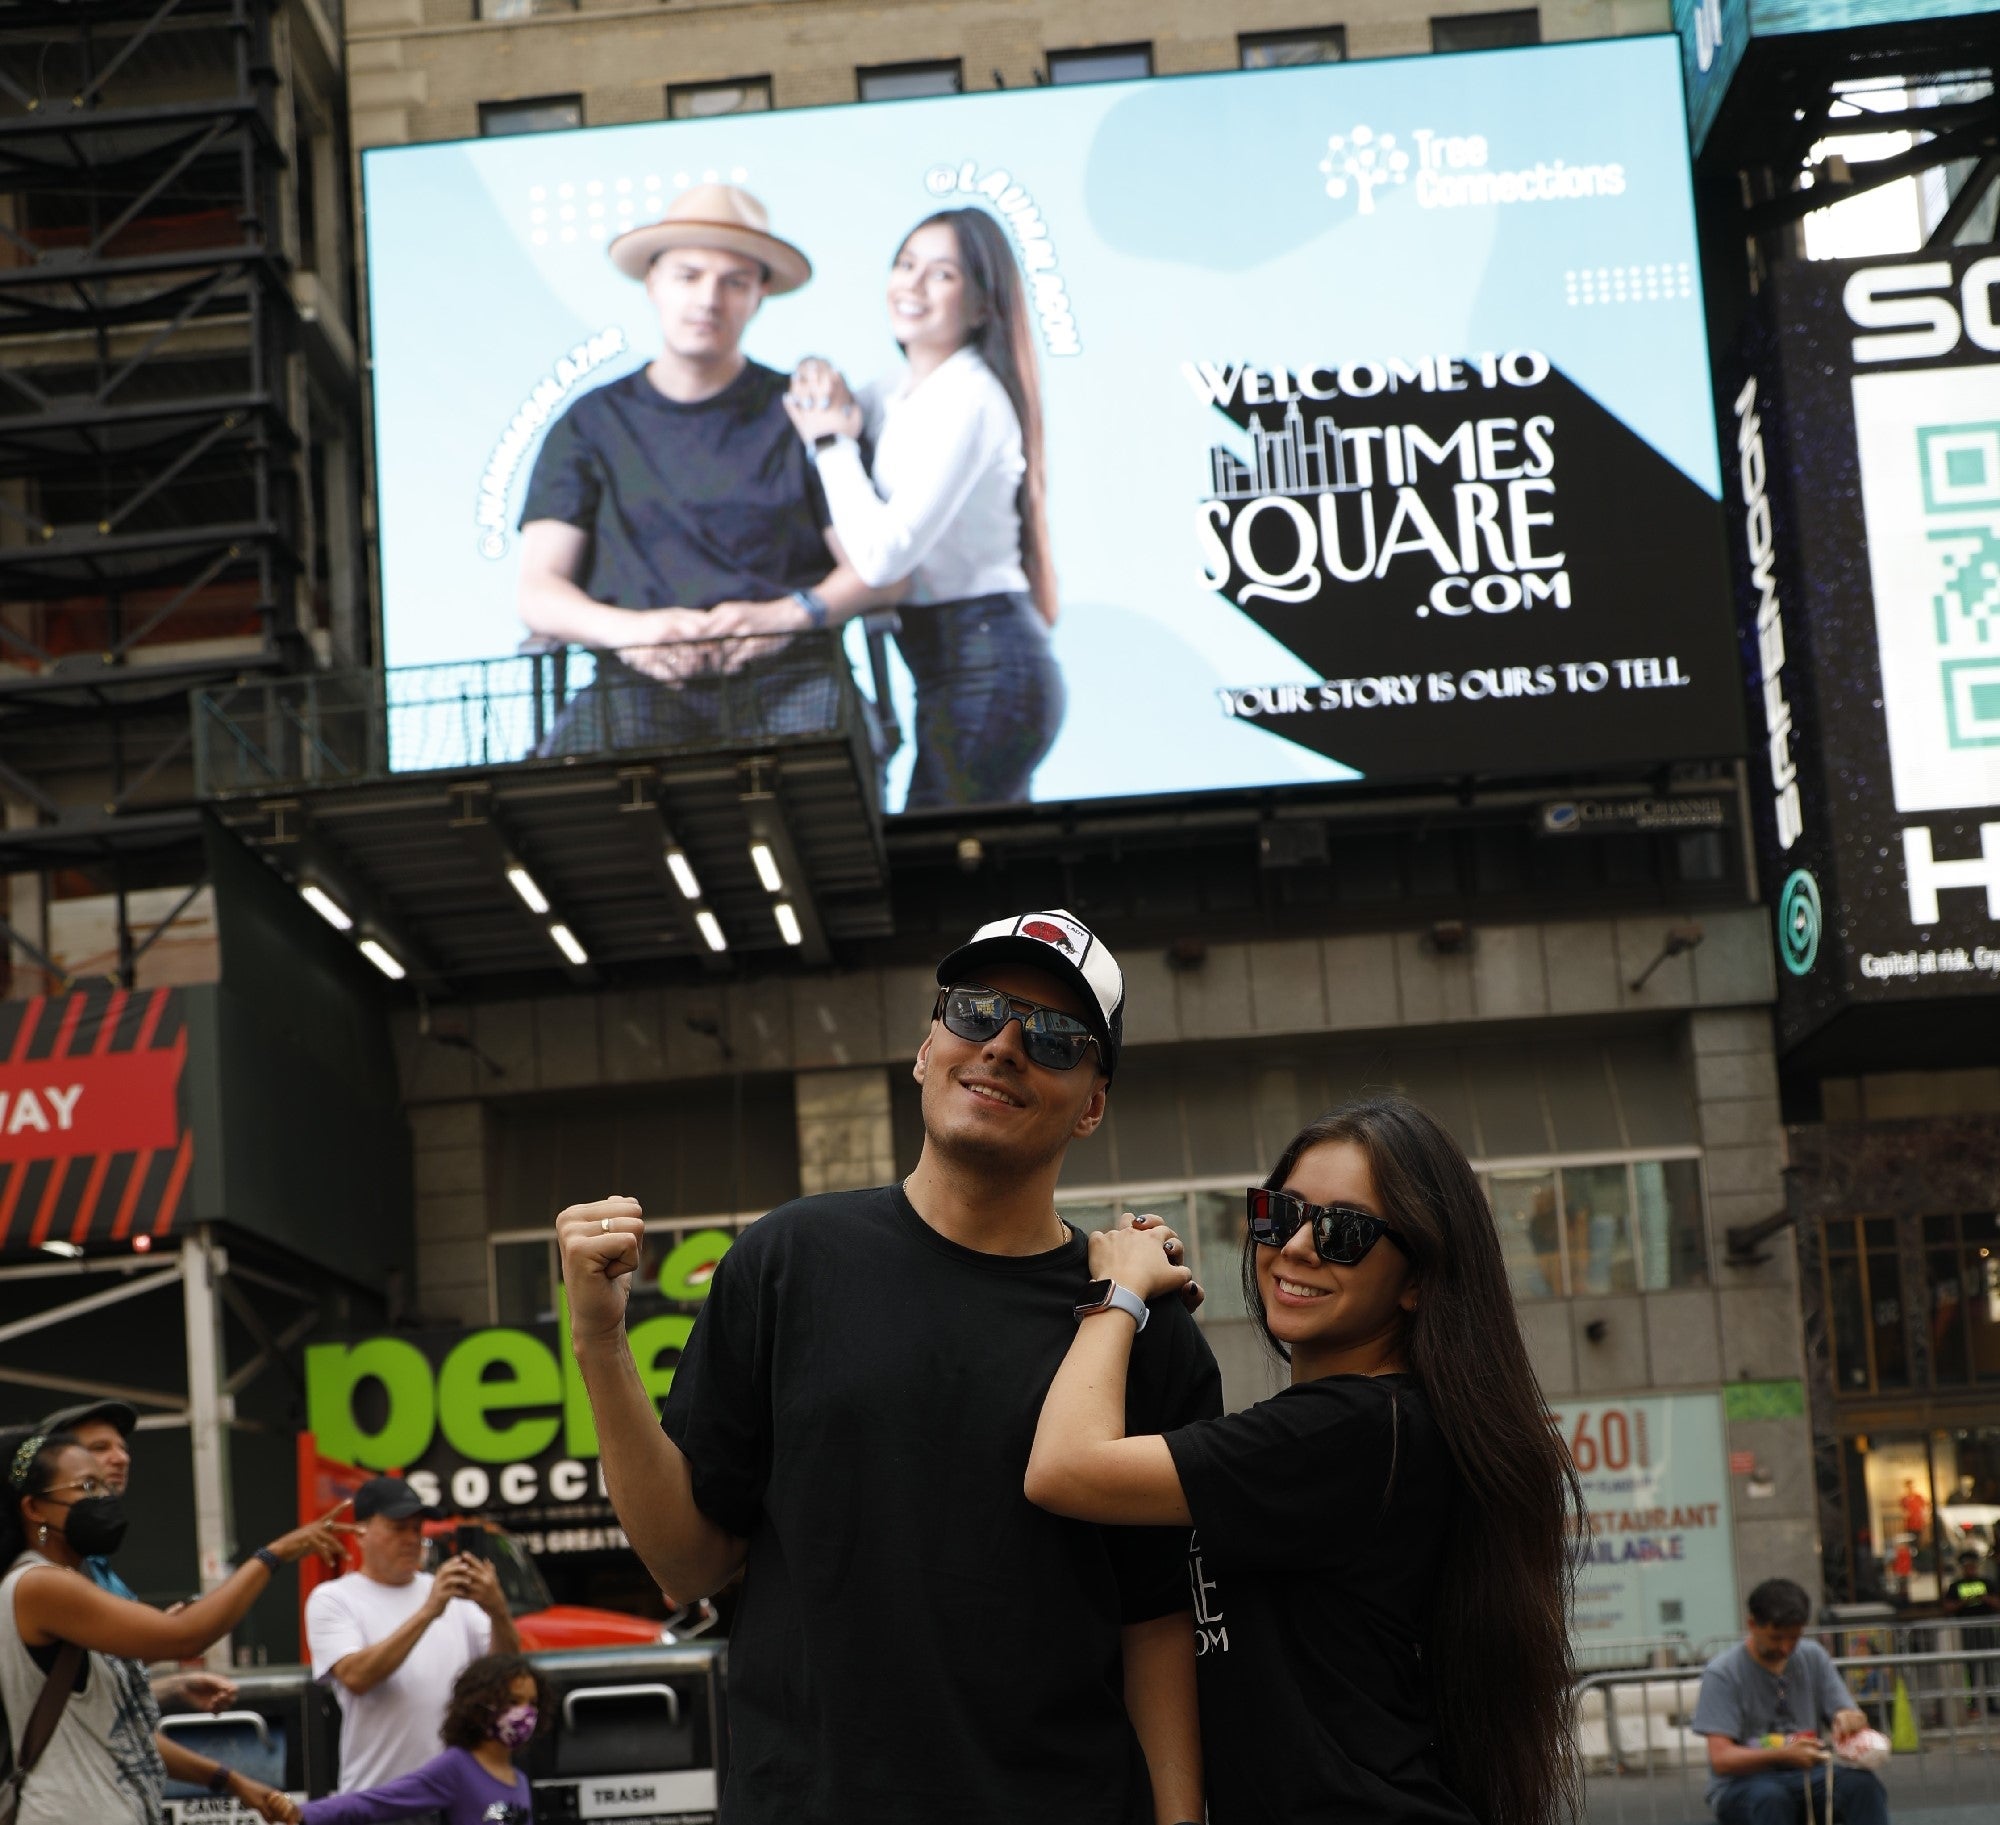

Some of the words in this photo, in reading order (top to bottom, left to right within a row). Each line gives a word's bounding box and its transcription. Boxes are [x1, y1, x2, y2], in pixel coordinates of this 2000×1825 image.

[1412, 129, 1488, 168] Tree
[1415, 159, 1627, 208] Connections
[1181, 357, 1469, 407] WELCOME
[1477, 349, 1551, 388] TO
[1341, 415, 1556, 489] TIMES
[1195, 479, 1567, 605] SQUARE
[1416, 571, 1572, 618] .COM
[1735, 375, 1803, 850] SAFEMOON
[1217, 686, 1313, 717] YOUR
[1319, 674, 1422, 711] STORY
[1427, 671, 1457, 702] IS
[1460, 665, 1557, 701] OURS
[1559, 660, 1609, 692] TO
[1861, 951, 1918, 979] Capital
[1919, 949, 1937, 974] at
[0, 1083, 84, 1135] AY
[594, 1785, 657, 1806] TRASH
